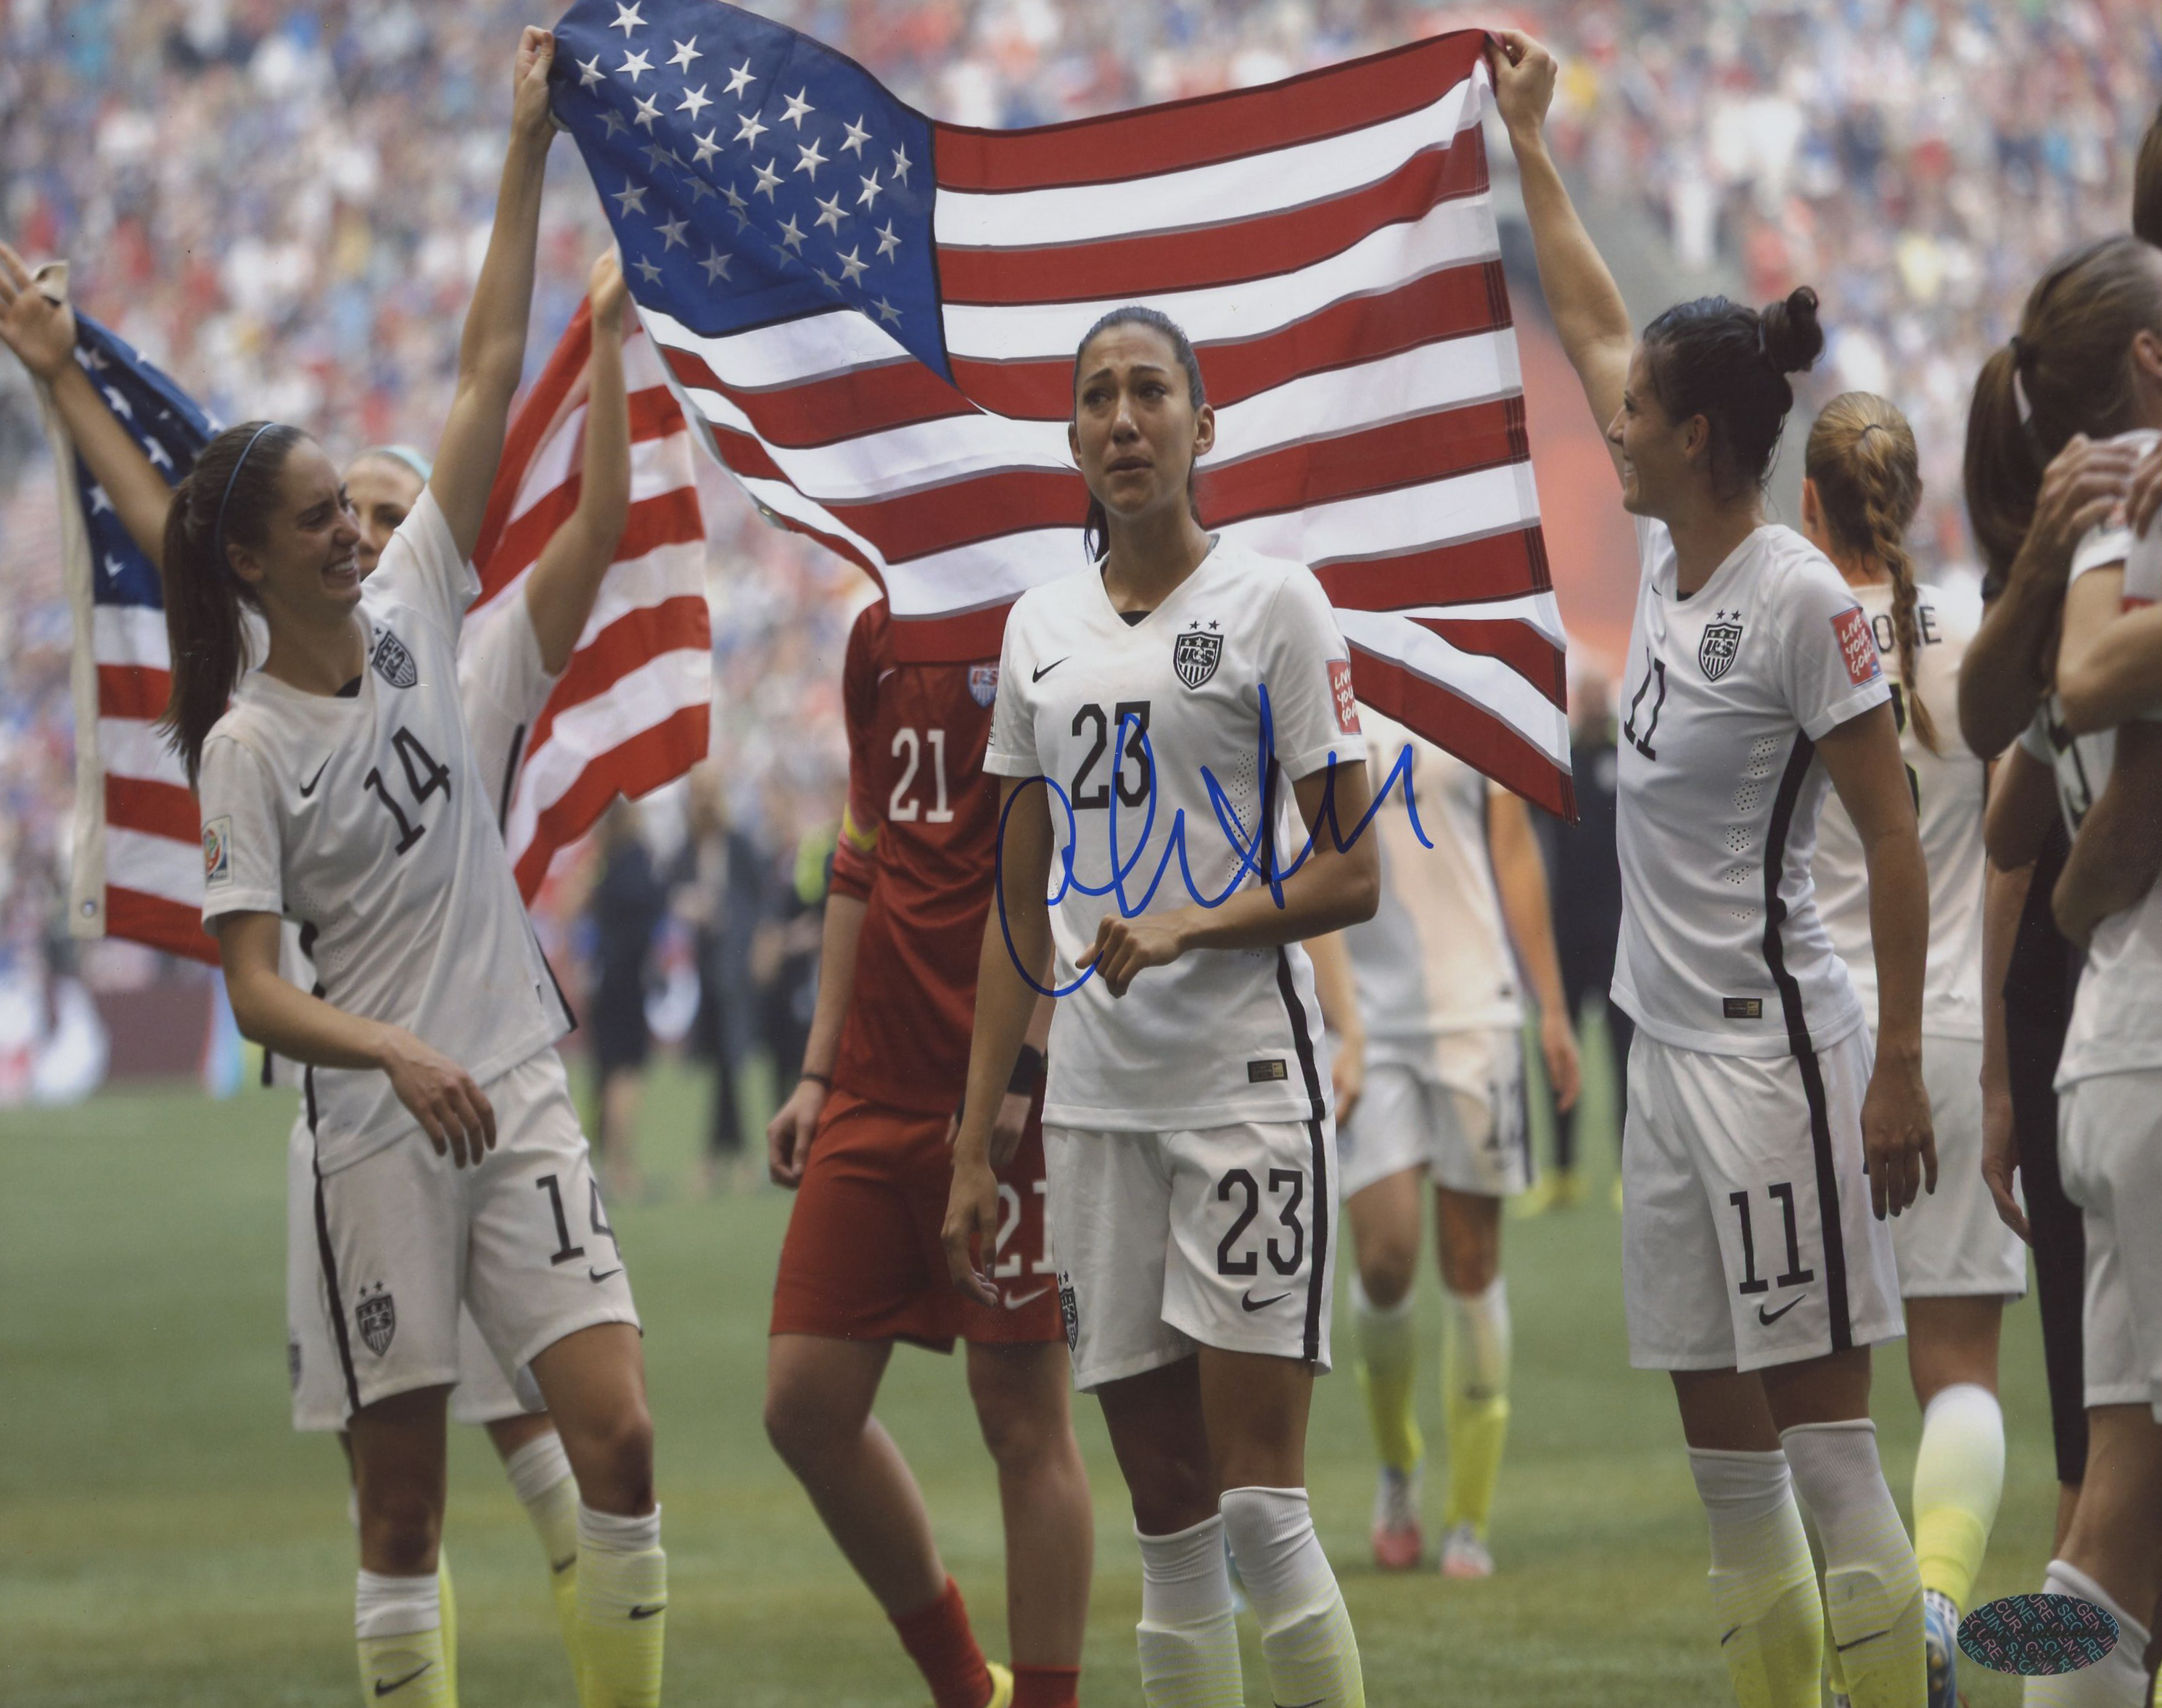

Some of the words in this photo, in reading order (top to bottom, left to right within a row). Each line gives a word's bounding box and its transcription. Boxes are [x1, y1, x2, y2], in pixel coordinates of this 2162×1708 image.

[1841, 615, 1863, 644] LIVE
[1070, 701, 1151, 810] 23
[1624, 645, 1666, 762] 11
[364, 726, 451, 855] 14
[888, 728, 955, 823] 21
[994, 1179, 1056, 1278] 21
[1217, 1168, 1304, 1276] 23
[1729, 1181, 1814, 1294] 11
